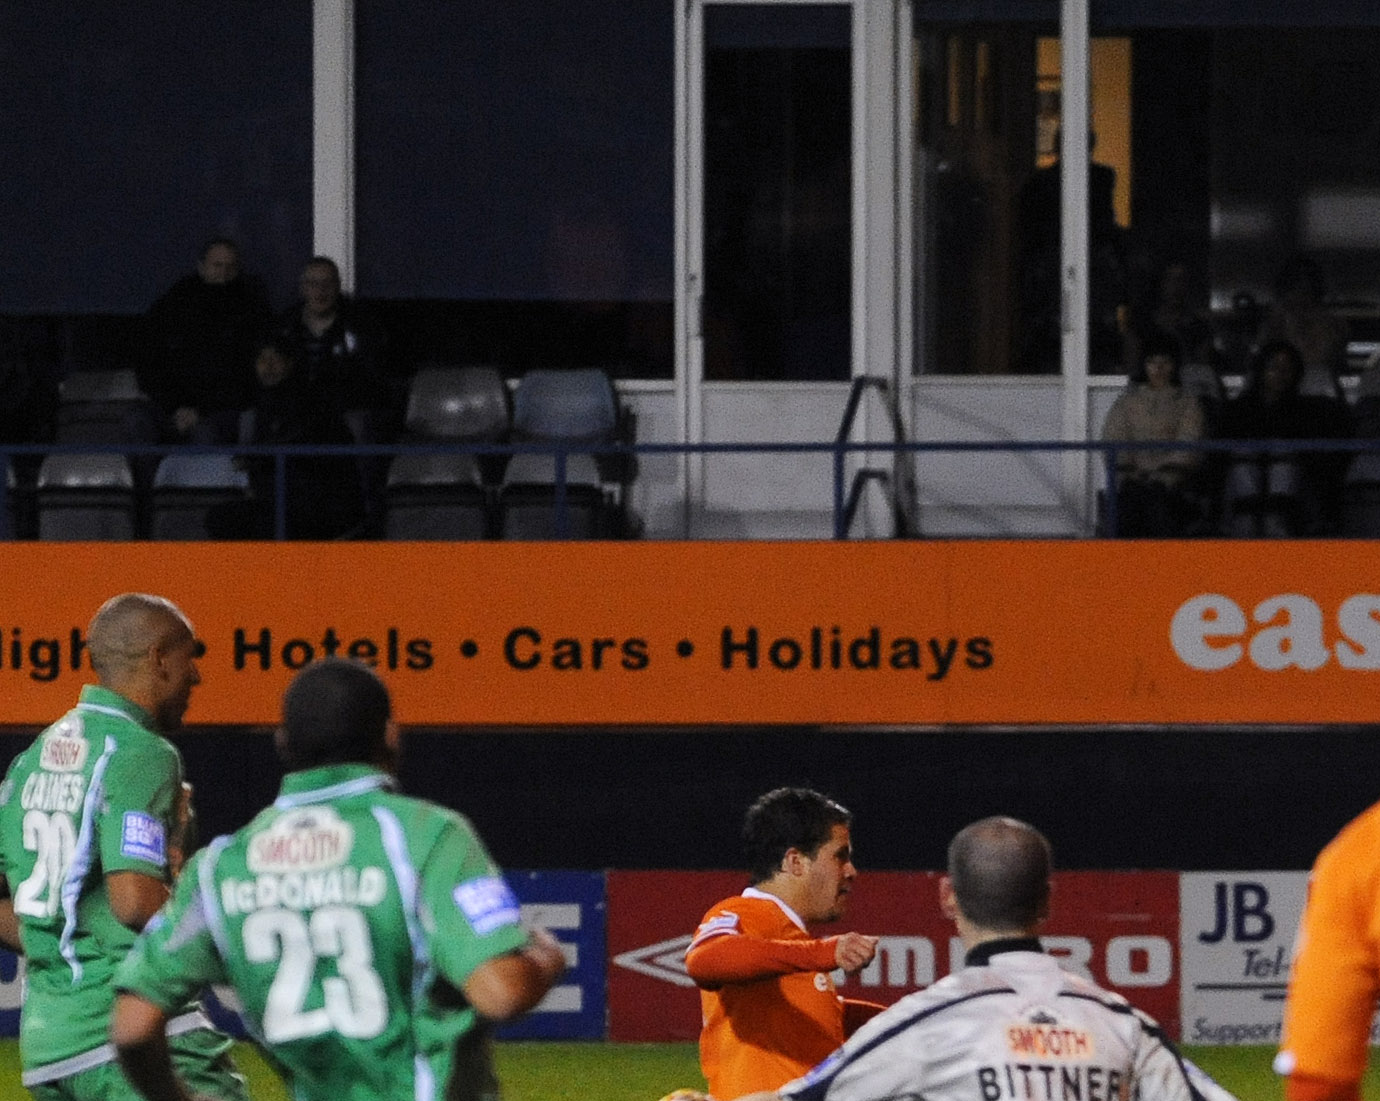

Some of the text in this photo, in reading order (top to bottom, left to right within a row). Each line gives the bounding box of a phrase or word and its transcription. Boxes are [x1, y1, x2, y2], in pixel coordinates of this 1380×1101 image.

[234, 627, 434, 671] Hotels
[503, 625, 650, 671] Cars
[720, 625, 995, 681] Holidays
[14, 810, 77, 918] 20
[1198, 881, 1275, 942] JB
[242, 903, 389, 1043] 23
[1009, 1027, 1088, 1056] SMOOTH
